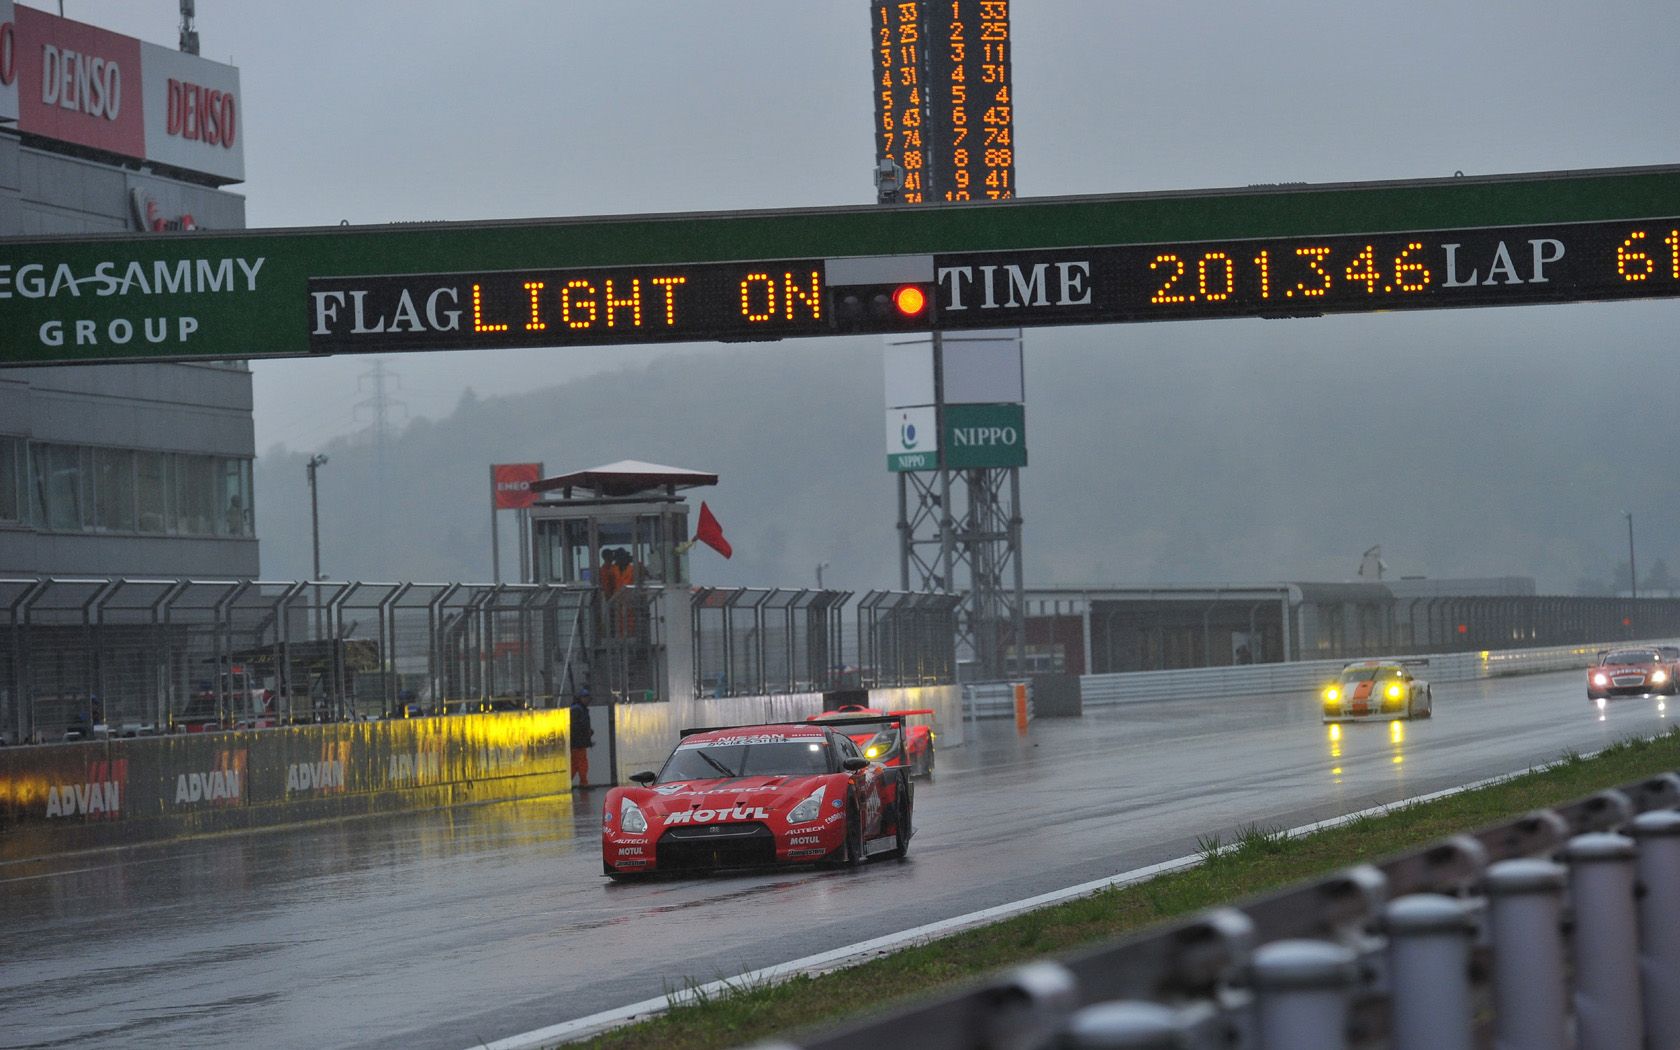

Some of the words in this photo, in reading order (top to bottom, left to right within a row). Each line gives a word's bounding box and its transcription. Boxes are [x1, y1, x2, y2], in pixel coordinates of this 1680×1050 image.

[880, 7, 888, 25] 1
[898, 2, 918, 21] 33
[951, 1, 959, 19] 1
[980, 1, 1007, 19] 33
[880, 28, 891, 46] 2
[899, 23, 919, 43] 25
[950, 22, 964, 40] 2
[980, 22, 1007, 40] 25
[881, 49, 892, 67] 3
[901, 45, 916, 64] 11
[951, 43, 965, 61] 3
[983, 43, 1004, 61] 11
[42, 44, 121, 121] DENSO
[882, 70, 893, 88] 4
[901, 66, 917, 85] 31
[952, 64, 965, 82] 4
[982, 64, 1004, 82] 31
[882, 91, 894, 110] 5
[909, 87, 920, 105] 4
[952, 86, 966, 103] 5
[996, 86, 1010, 103] 4
[167, 78, 236, 149] DENSO
[883, 112, 894, 130] 6
[903, 108, 921, 127] 43
[953, 107, 967, 125] 6
[984, 107, 1010, 125] 43
[884, 133, 894, 151] 7
[903, 130, 921, 148] 74
[954, 128, 968, 146] 7
[984, 128, 1010, 146] 74
[903, 150, 922, 169] 88
[954, 149, 969, 167] 8
[985, 149, 1012, 167] 88
[905, 171, 921, 190] 41
[955, 170, 969, 188] 9
[986, 170, 1008, 188] 41
[1441, 239, 1566, 288] LAP
[1617, 230, 1680, 281] 61
[938, 260, 1092, 311] TIME
[312, 286, 463, 335] FLAG
[473, 277, 686, 332] LIGHT
[740, 271, 820, 322] ON
[39, 316, 199, 346] GROUP
[953, 427, 1017, 446] NIPPO
[898, 454, 925, 468] NIPPO
[497, 481, 530, 490] ENEO
[287, 760, 344, 792] ADVAN
[175, 770, 240, 804] ADVAN
[46, 781, 120, 818] ADVAN
[662, 806, 769, 825] MOTUL
[785, 825, 825, 836] AUTECH
[790, 835, 820, 845] MOTUL
[618, 846, 643, 856] MOTUL
